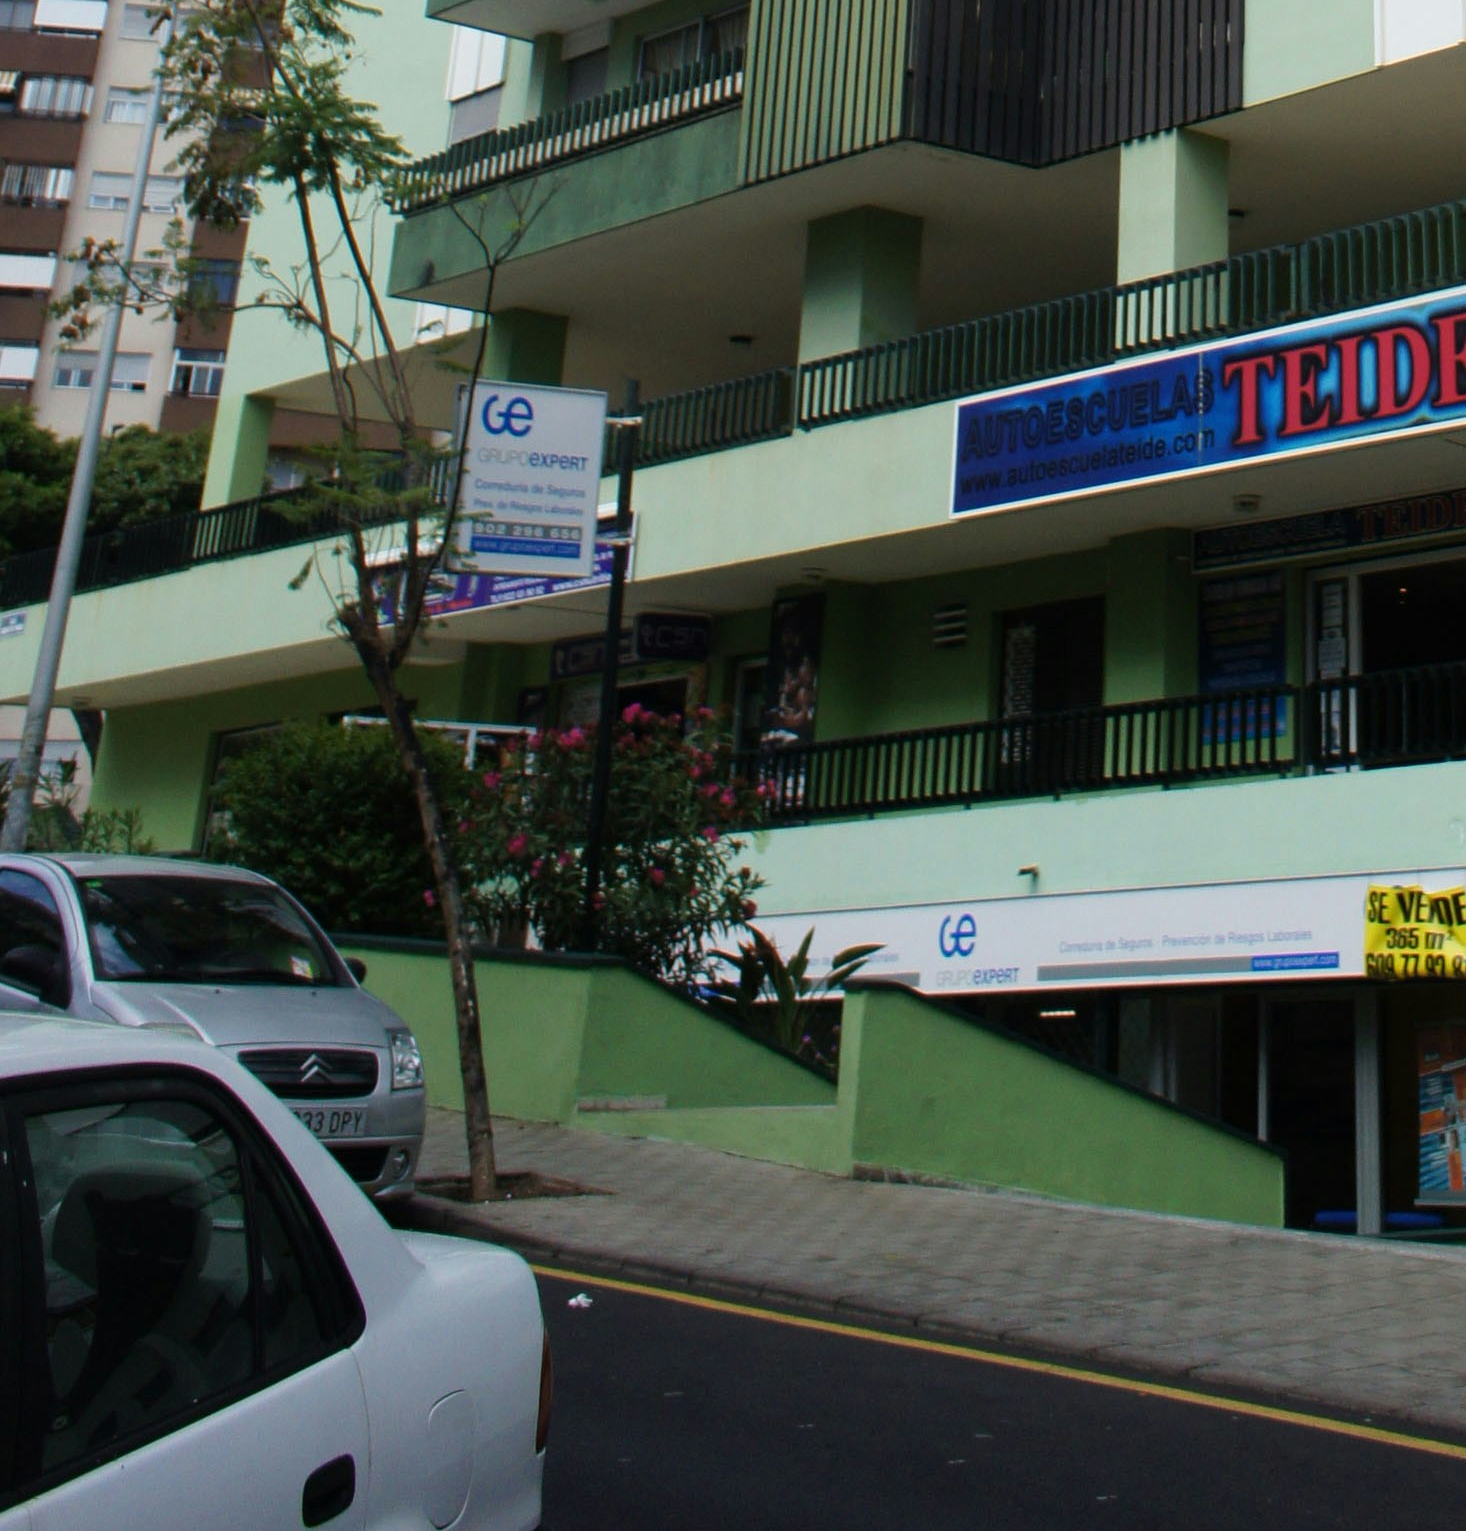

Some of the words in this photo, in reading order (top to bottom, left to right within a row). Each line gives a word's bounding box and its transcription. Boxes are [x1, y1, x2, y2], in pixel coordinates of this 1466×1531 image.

[962, 368, 1215, 463] AUTOESCUELAS
[959, 426, 1215, 495] www.autoescuelateide.com
[1367, 890, 1391, 924] SE
[1386, 927, 1420, 950] 365
[1401, 953, 1420, 977] 77
[328, 1111, 362, 1134] DPY
